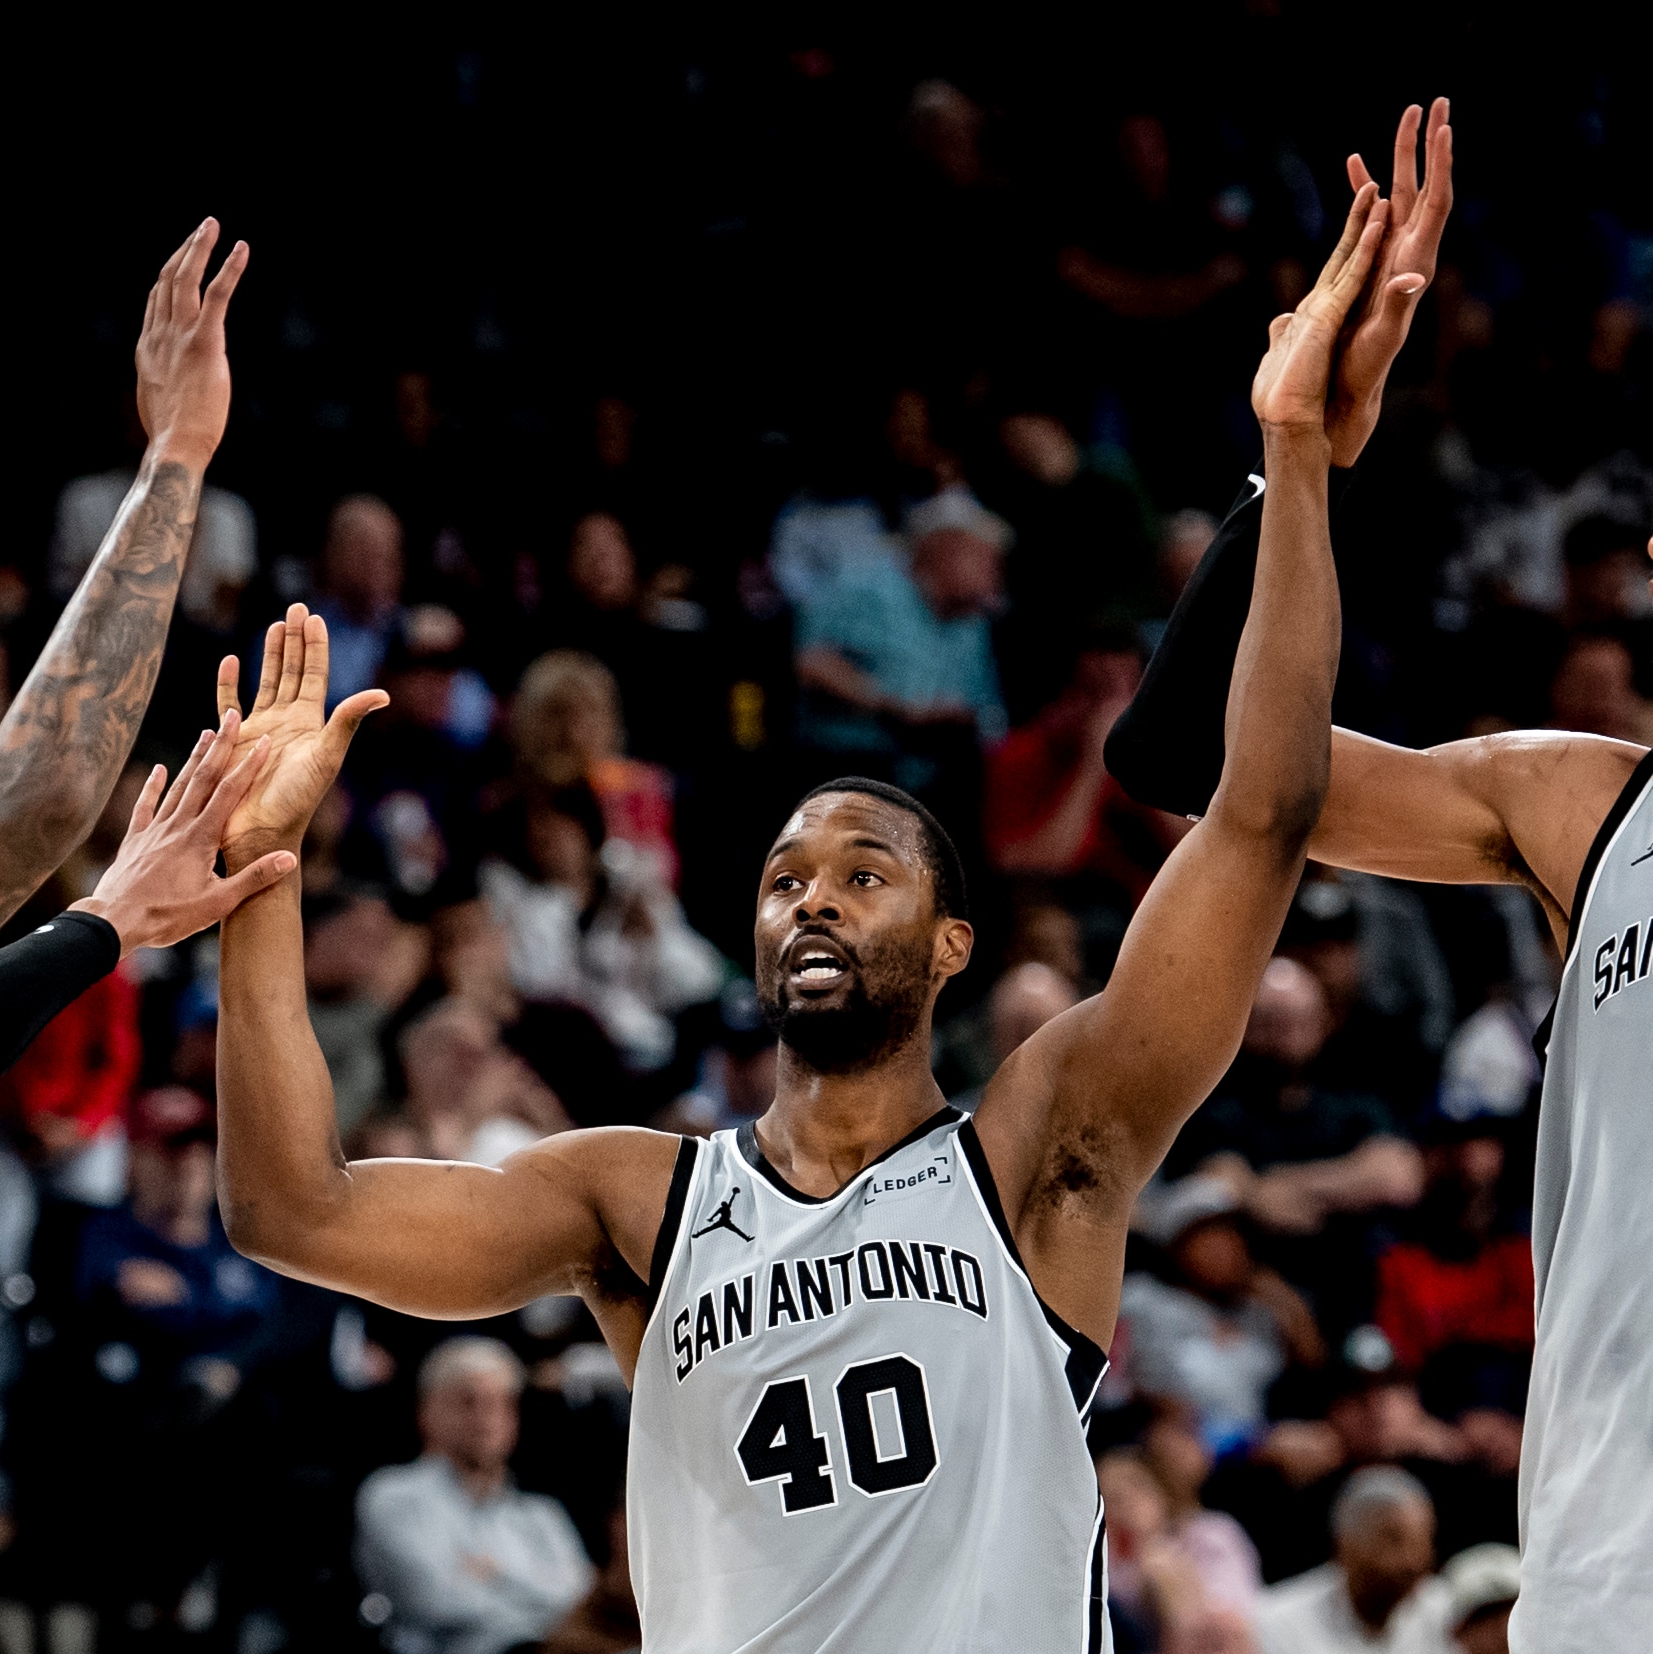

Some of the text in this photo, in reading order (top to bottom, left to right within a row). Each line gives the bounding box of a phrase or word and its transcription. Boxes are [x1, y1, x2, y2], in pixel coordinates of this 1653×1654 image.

[872, 1165, 938, 1195] LEDGER
[672, 1239, 988, 1385] SAN ANTONIO
[733, 1352, 941, 1517] 40
